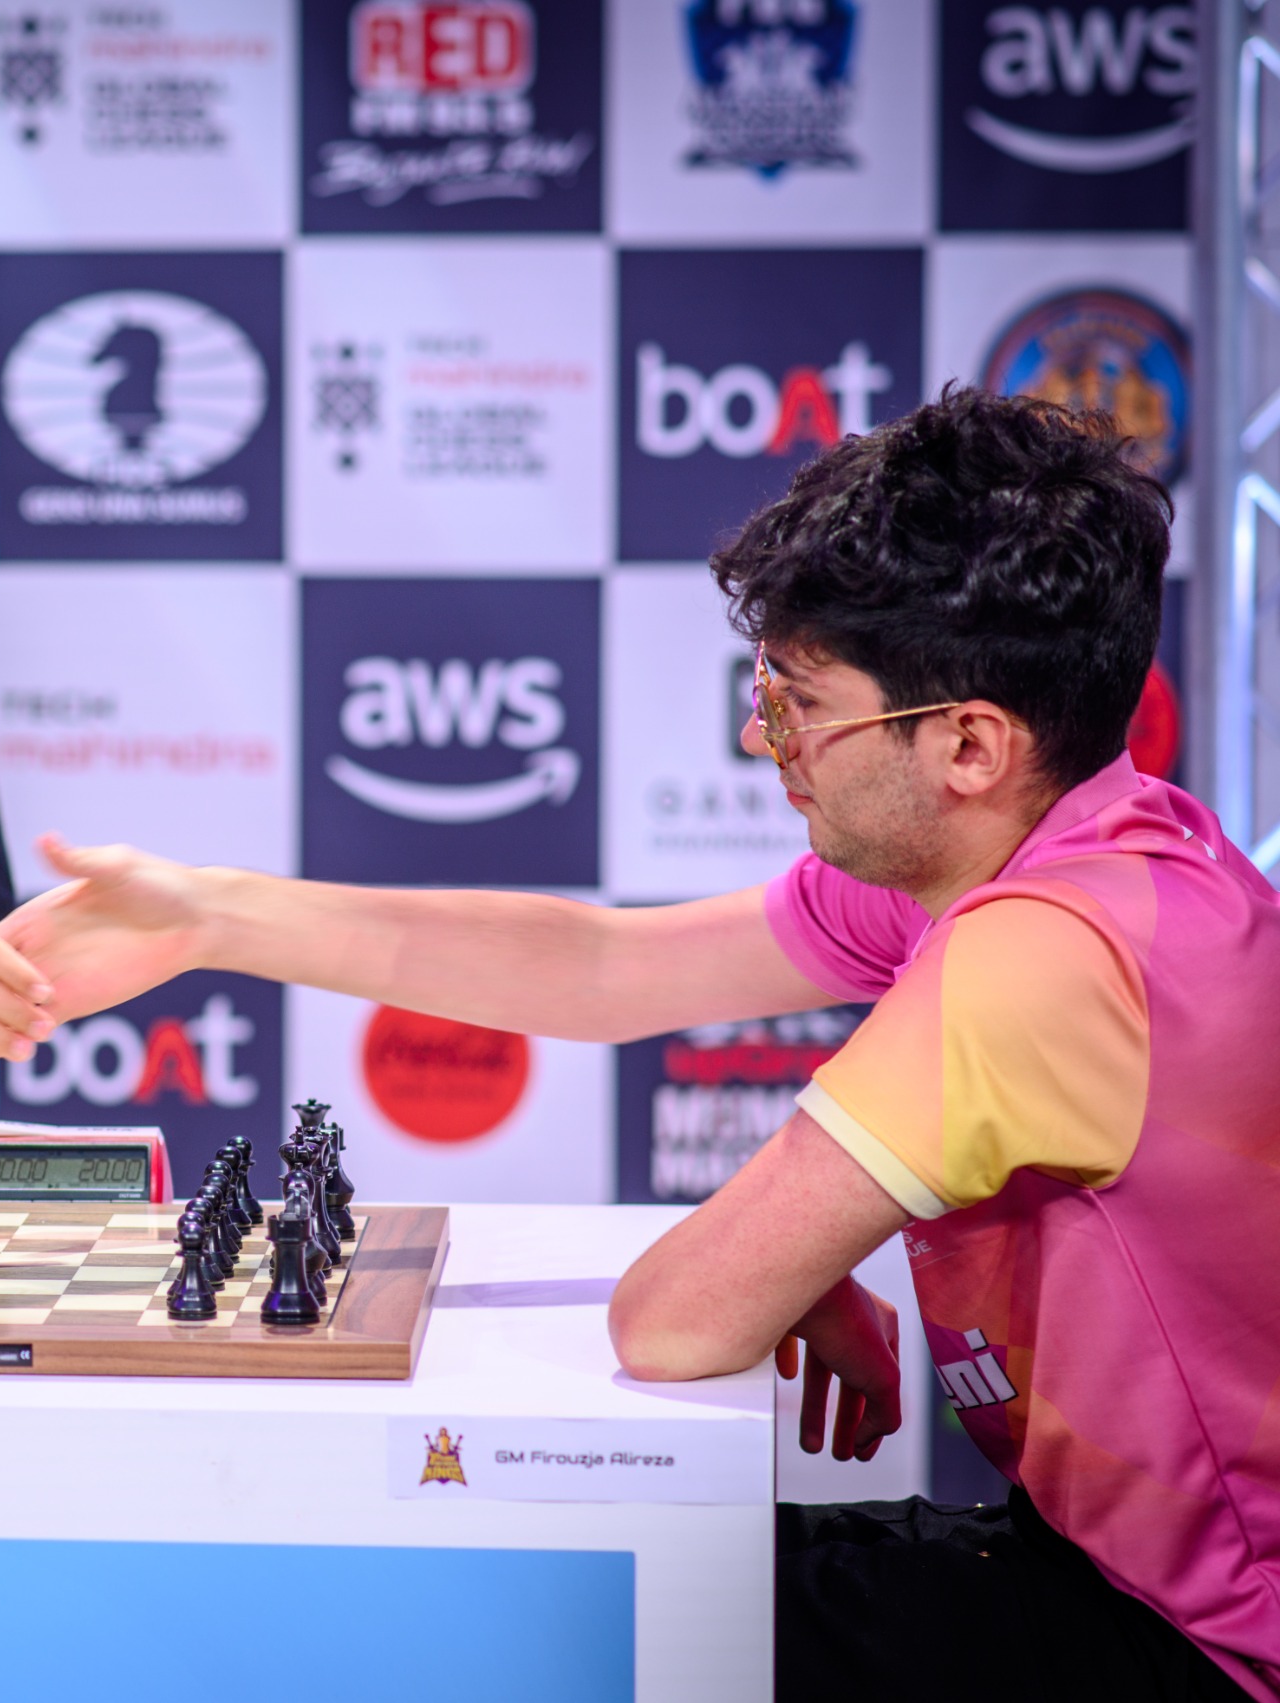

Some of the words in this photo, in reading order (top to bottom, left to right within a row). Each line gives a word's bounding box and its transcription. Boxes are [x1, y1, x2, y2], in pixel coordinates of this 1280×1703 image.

[982, 8, 1196, 95] aws
[341, 658, 564, 747] aws
[495, 1450, 525, 1464] GM
[531, 1450, 604, 1468] Firouzja
[610, 1452, 674, 1467] Alireza
